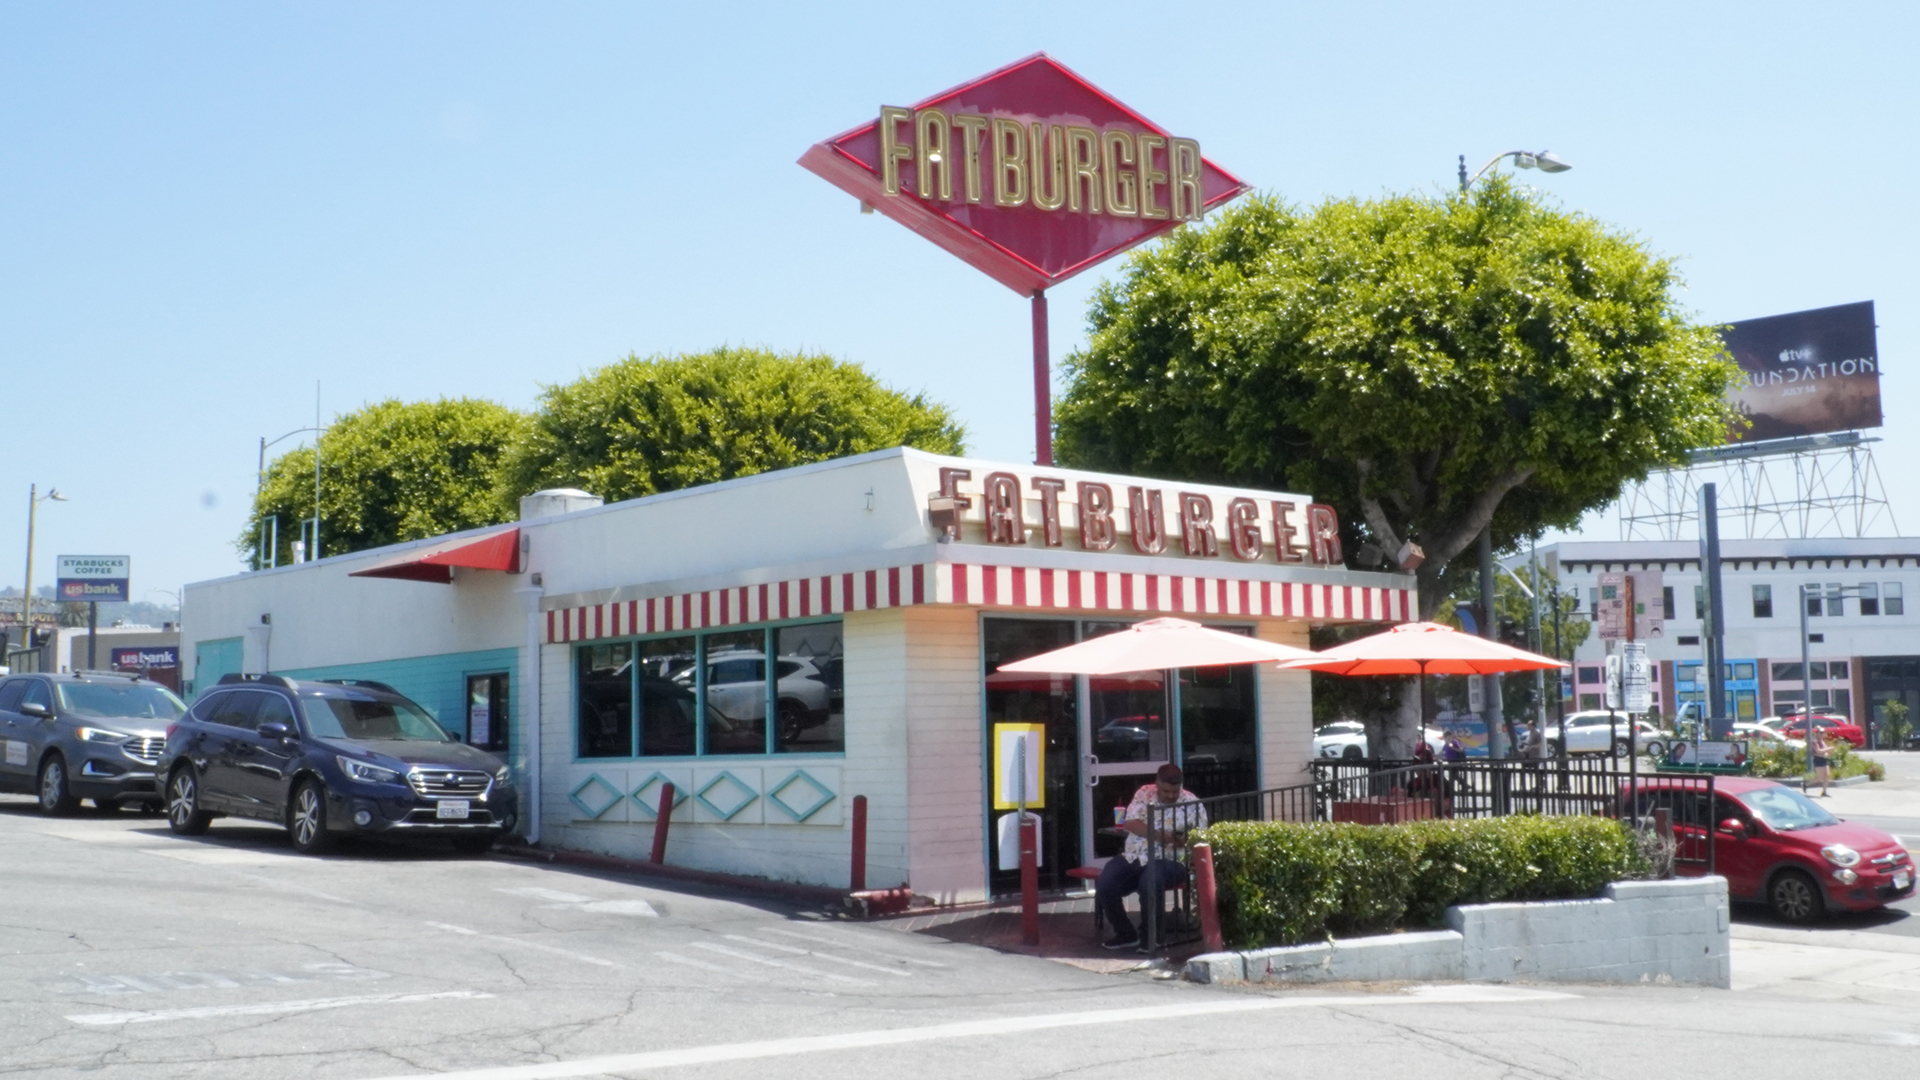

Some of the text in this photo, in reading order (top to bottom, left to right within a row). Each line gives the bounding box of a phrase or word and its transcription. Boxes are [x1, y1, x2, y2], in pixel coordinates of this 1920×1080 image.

[879, 103, 1205, 223] FATBURGER
[1736, 356, 1875, 389] UNDATION
[1781, 385, 1816, 397] JULY 14
[938, 466, 1344, 566] FATBURGER
